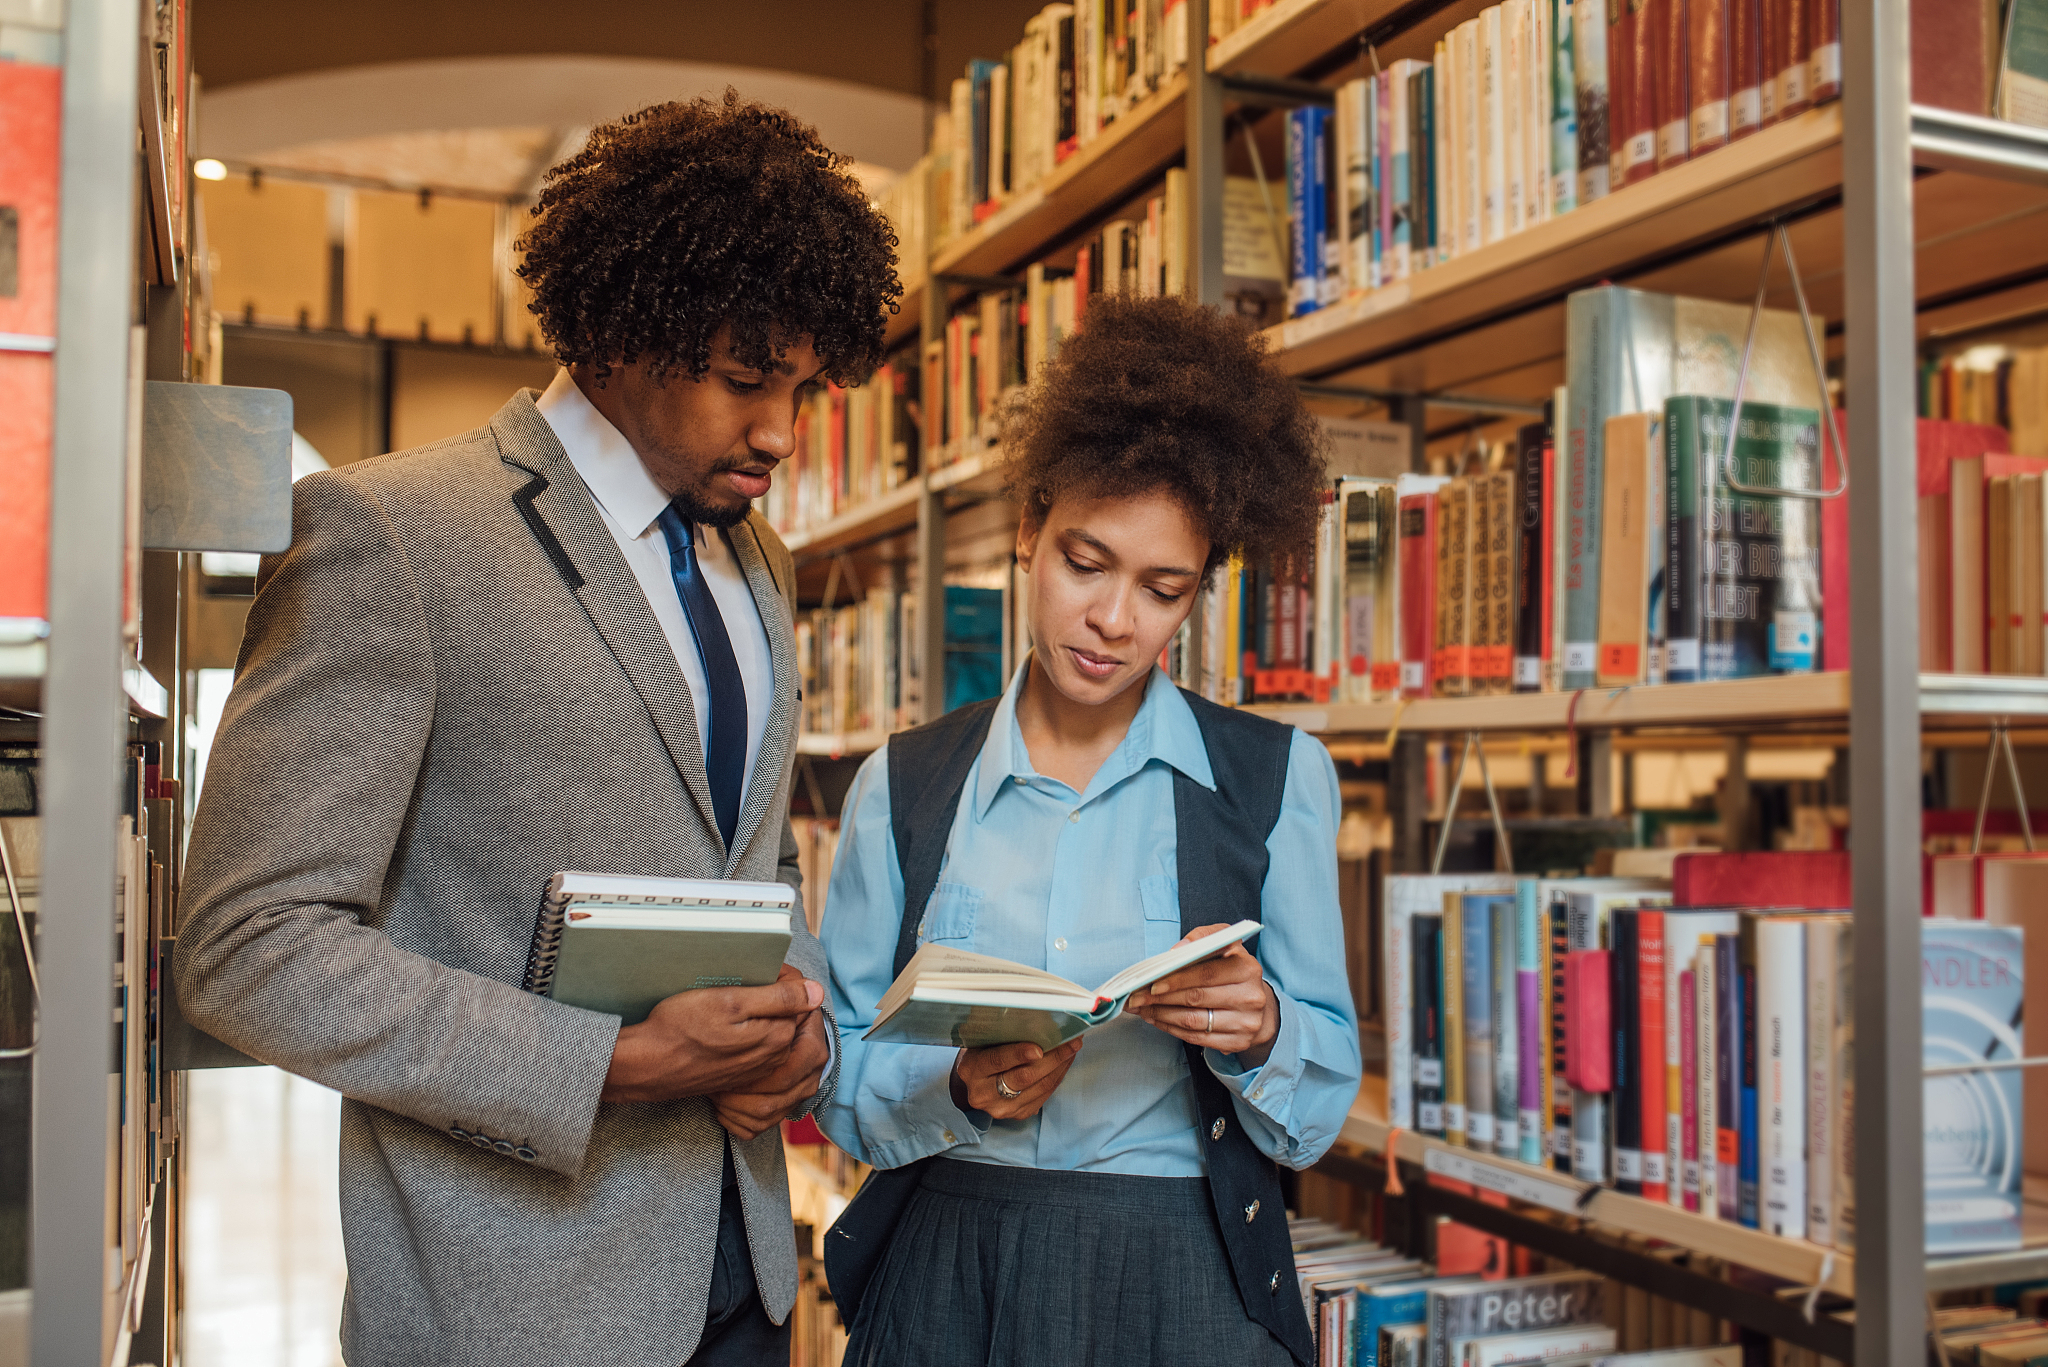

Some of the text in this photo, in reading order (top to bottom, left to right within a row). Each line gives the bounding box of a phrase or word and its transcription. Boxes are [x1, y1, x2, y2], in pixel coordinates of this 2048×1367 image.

[1293, 200, 1305, 274] JOHANN
[1590, 394, 1598, 408] und
[1702, 414, 1817, 446] OLGA GRJASNOWA
[1589, 437, 1597, 463] Brüder
[1569, 429, 1585, 509] einmal
[1702, 453, 1741, 488] DER
[1454, 489, 1466, 502] II
[1475, 481, 1487, 504] III
[1522, 447, 1539, 527] Grimm
[1588, 478, 1596, 510] Märchen
[1670, 490, 1678, 512] RUSSE
[1453, 507, 1466, 554] Bajke
[1475, 506, 1487, 554] Bajke
[1493, 502, 1509, 551] Bajke
[1702, 497, 1735, 532] IST
[1521, 536, 1529, 570] Martus
[1570, 516, 1583, 558] war
[1703, 540, 1743, 576] DER
[1450, 559, 1467, 600] Grim
[1474, 559, 1488, 601] Grim
[1492, 556, 1510, 600] Grim
[1566, 563, 1582, 589] Es
[1704, 584, 1760, 620] LIEBT
[1780, 623, 1810, 631] deutscher
[1780, 630, 1794, 638] buch
[1704, 659, 1737, 671] HANSER
[1773, 657, 1795, 665] Longlist
[1518, 939, 1526, 961] DURS
[1639, 952, 1664, 963] Haas
[1640, 939, 1663, 949] Wolf
[1666, 945, 1676, 974] Jahren
[1445, 911, 1456, 1015] Beziehungsreise
[1922, 958, 2011, 987] NDLER
[1390, 928, 1403, 1042] Walpurgistag
[1668, 977, 1675, 987] 15
[1683, 983, 1691, 1028] Liebesleben
[1520, 1036, 1526, 1047] IM
[1745, 968, 1754, 1085] Peter Hacks Die Erzählungen
[1668, 1040, 1676, 1058] Das
[1701, 964, 1711, 1146] Erich Hackl Anprobieren eines Vaters
[1684, 1083, 1692, 1103] Beste
[1771, 1017, 1782, 1158] Haderer Der bessere Mensch
[1669, 1122, 1677, 1143] Haas
[1687, 1169, 1696, 1177] 830
[1706, 1185, 1712, 1196] d
[1393, 1300, 1426, 1313] CHRIS
[1483, 1293, 1573, 1328] Peter
[1435, 1300, 1445, 1367] och Sturm
